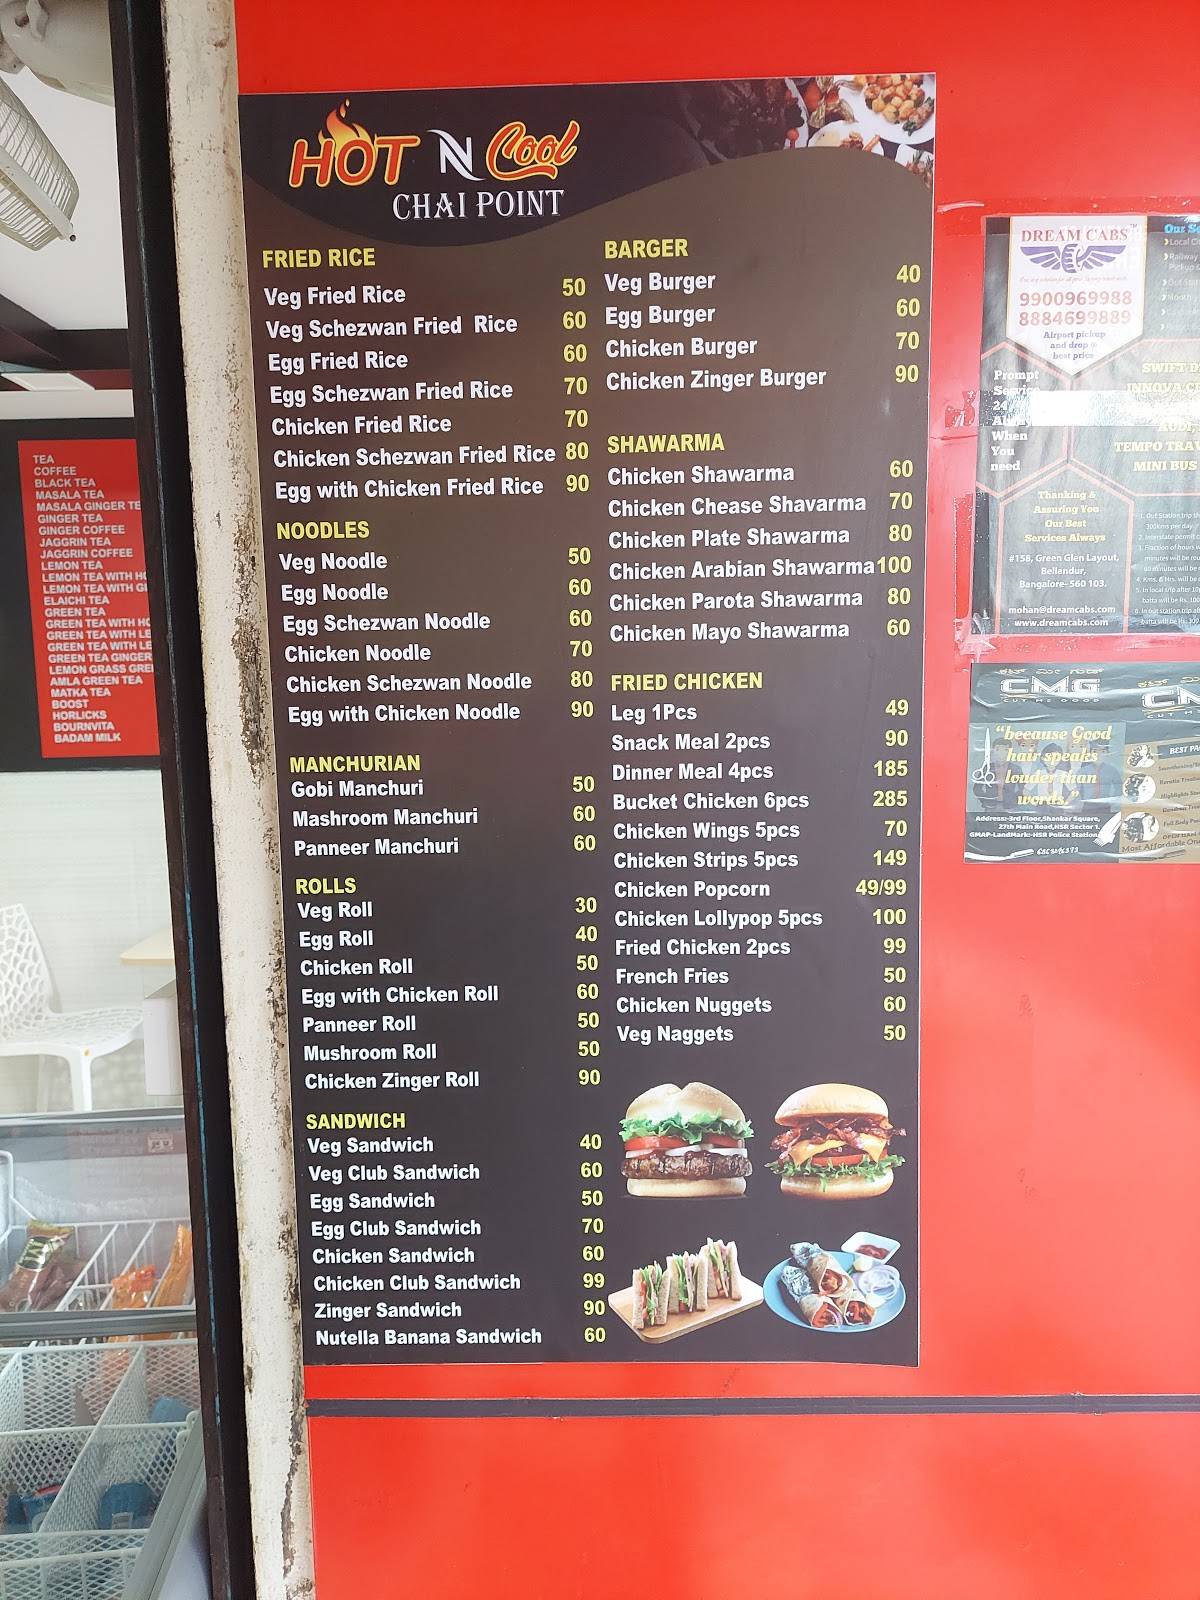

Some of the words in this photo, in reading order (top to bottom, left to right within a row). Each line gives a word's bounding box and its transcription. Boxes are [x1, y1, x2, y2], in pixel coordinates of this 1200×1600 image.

[289, 134, 420, 188] HOT
[427, 129, 485, 182] N
[486, 120, 580, 182] Cool
[393, 192, 466, 220] CHAI
[476, 190, 564, 218] POINT
[1021, 229, 1081, 242] DREAM
[1086, 228, 1128, 241] CABS
[604, 238, 689, 260] BARGER
[262, 248, 322, 269] FRIED
[328, 247, 376, 268] RICE
[603, 273, 642, 296] Veg
[648, 271, 717, 295] Burger
[896, 264, 921, 284] 40
[263, 287, 302, 311] Veg
[307, 285, 357, 305] Fried
[362, 284, 406, 304] Rice
[562, 277, 586, 297] 50
[1020, 290, 1132, 306] 9900969988
[1019, 310, 1131, 326] 8884699889
[1043, 331, 1074, 340] Airport
[1076, 330, 1106, 340] pickup
[606, 371, 685, 391] Chicken
[690, 369, 755, 393] Zinger
[760, 368, 827, 391] Burger
[895, 364, 919, 383] 90
[994, 370, 1040, 383] Prompt
[269, 385, 307, 409] Egg
[311, 384, 410, 403] Schezwan
[415, 381, 464, 401] Fried
[469, 380, 514, 399] Rice
[563, 376, 588, 396] 70
[607, 432, 725, 454] SHAWARMA
[992, 430, 1028, 441] When
[273, 449, 351, 468] Chicken
[355, 447, 453, 467] Schezwan
[458, 444, 507, 464] Fried
[513, 444, 556, 463] Rice
[565, 441, 589, 461] 80
[991, 446, 1015, 456] You
[33, 455, 54, 464] TEA
[991, 460, 1020, 471] need
[1133, 461, 1168, 471] MINI
[1170, 460, 1198, 471] BUS
[34, 467, 76, 475] COFFEE
[35, 479, 71, 487] BLACK
[36, 491, 80, 499] MASALA
[84, 490, 104, 498] TEA
[1038, 491, 1086, 500] Thanking
[608, 498, 685, 518] Chicken
[691, 497, 763, 516] Chease
[768, 495, 867, 514] Shavarma
[889, 491, 913, 510] 70
[1033, 505, 1078, 514] Assuring
[1080, 505, 1100, 513] You
[39, 526, 80, 535] GINGER
[83, 525, 124, 534] COFFEE
[276, 520, 370, 540] NOODLES
[1045, 519, 1063, 528] Our
[1065, 519, 1087, 527] Best
[1024, 534, 1067, 542] Services
[1069, 533, 1106, 543] Always
[40, 550, 88, 558] JAGGRIN
[91, 548, 132, 558] COFFEE
[278, 552, 316, 575] Veg
[321, 551, 388, 570] Noodle
[568, 546, 591, 565] 50
[1035, 554, 1062, 562] Green
[1064, 553, 1085, 562] Glen
[42, 562, 79, 570] LEMON
[82, 561, 102, 569] TEA
[609, 562, 686, 581] Chicken
[690, 559, 766, 579] Arabian
[771, 557, 876, 578] Shawarma
[876, 555, 912, 575] 100
[1070, 580, 1086, 588] 560
[44, 596, 86, 605] ELAICHI
[88, 596, 109, 604] TEA
[1008, 605, 1116, 614] mohan@dreamcabs.com
[1014, 619, 1109, 627] www.dreamcabs.com
[48, 654, 85, 663] GREEN
[88, 654, 109, 662] TEA
[50, 677, 80, 686] AMLA
[82, 676, 119, 685] GREEN
[122, 676, 143, 684] TEA
[611, 673, 668, 692] FRIED
[673, 671, 763, 691] CHICKEN
[1000, 676, 1101, 695] CMG
[51, 688, 88, 697] MATKA
[90, 688, 111, 696] TEA
[52, 700, 88, 709] BOOST
[611, 704, 646, 726] Leg
[651, 703, 698, 721] 1Pcs
[885, 698, 909, 716] 49
[53, 710, 107, 720] HORLICKS
[54, 722, 114, 732] BOURNVITA
[1072, 725, 1112, 744] Good
[54, 734, 93, 743] BADAM
[95, 733, 121, 742] MILK
[289, 754, 421, 773] MANCHURIAN
[1007, 747, 1039, 761] hair
[1044, 747, 1098, 765] speaks
[1005, 769, 1056, 784] louder
[1060, 770, 1097, 784] than
[290, 780, 334, 798] Gobi
[338, 778, 424, 797] Manchuri
[572, 775, 595, 793] 50
[612, 793, 678, 811] Bucket
[683, 792, 759, 810] Chicken
[763, 791, 810, 813] 6pcs
[872, 790, 908, 807] 285
[292, 809, 389, 828] Mashroom
[393, 807, 478, 825] Manchuri
[572, 805, 596, 822] 60
[1143, 839, 1186, 851] Affordable
[295, 877, 357, 895] ROLLS
[614, 880, 688, 898] Chicken
[693, 880, 771, 901] Popcorn
[855, 878, 907, 896] 49/99
[296, 902, 333, 923] Veg
[338, 900, 373, 918] Roll
[575, 896, 597, 914] 30
[301, 988, 336, 1009] Egg
[340, 987, 381, 1004] with
[385, 986, 459, 1003] Chicken
[464, 984, 499, 1002] Roll
[576, 983, 599, 1000] 60
[616, 1025, 652, 1046] Veg
[657, 1025, 734, 1046] Naggets
[883, 1024, 906, 1041] 50
[305, 1112, 406, 1130] SANDWICH
[307, 1165, 343, 1186] Veg
[347, 1164, 388, 1181] Club
[392, 1163, 480, 1181] Sandwich
[580, 1161, 603, 1178] 60
[315, 1329, 380, 1346] Nutella
[384, 1329, 451, 1345] Banana
[455, 1327, 542, 1345] Sandwich
[584, 1326, 606, 1343] 60
